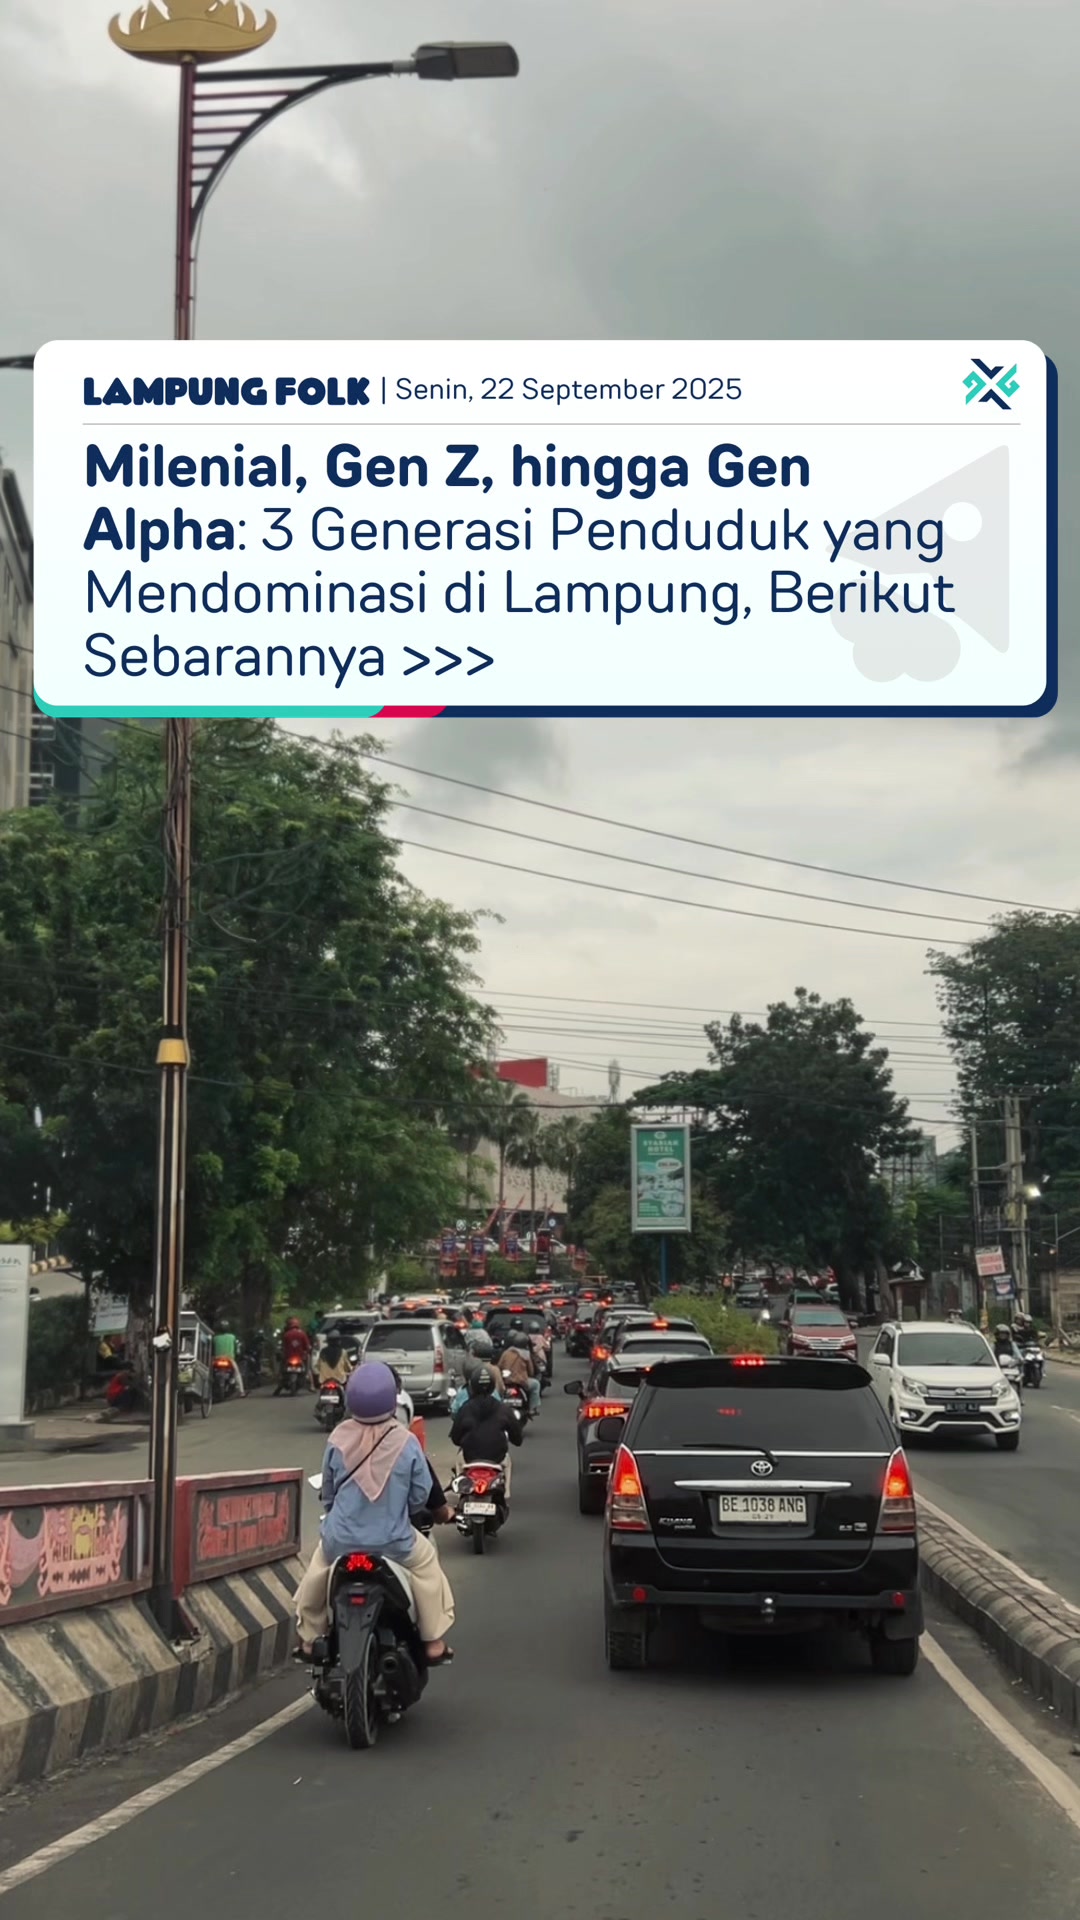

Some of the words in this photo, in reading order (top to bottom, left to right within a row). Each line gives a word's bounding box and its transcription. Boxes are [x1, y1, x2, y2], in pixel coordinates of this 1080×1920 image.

[722, 1497, 738, 1512] BE
[742, 1497, 775, 1512] 1038
[779, 1498, 804, 1513] ANG
